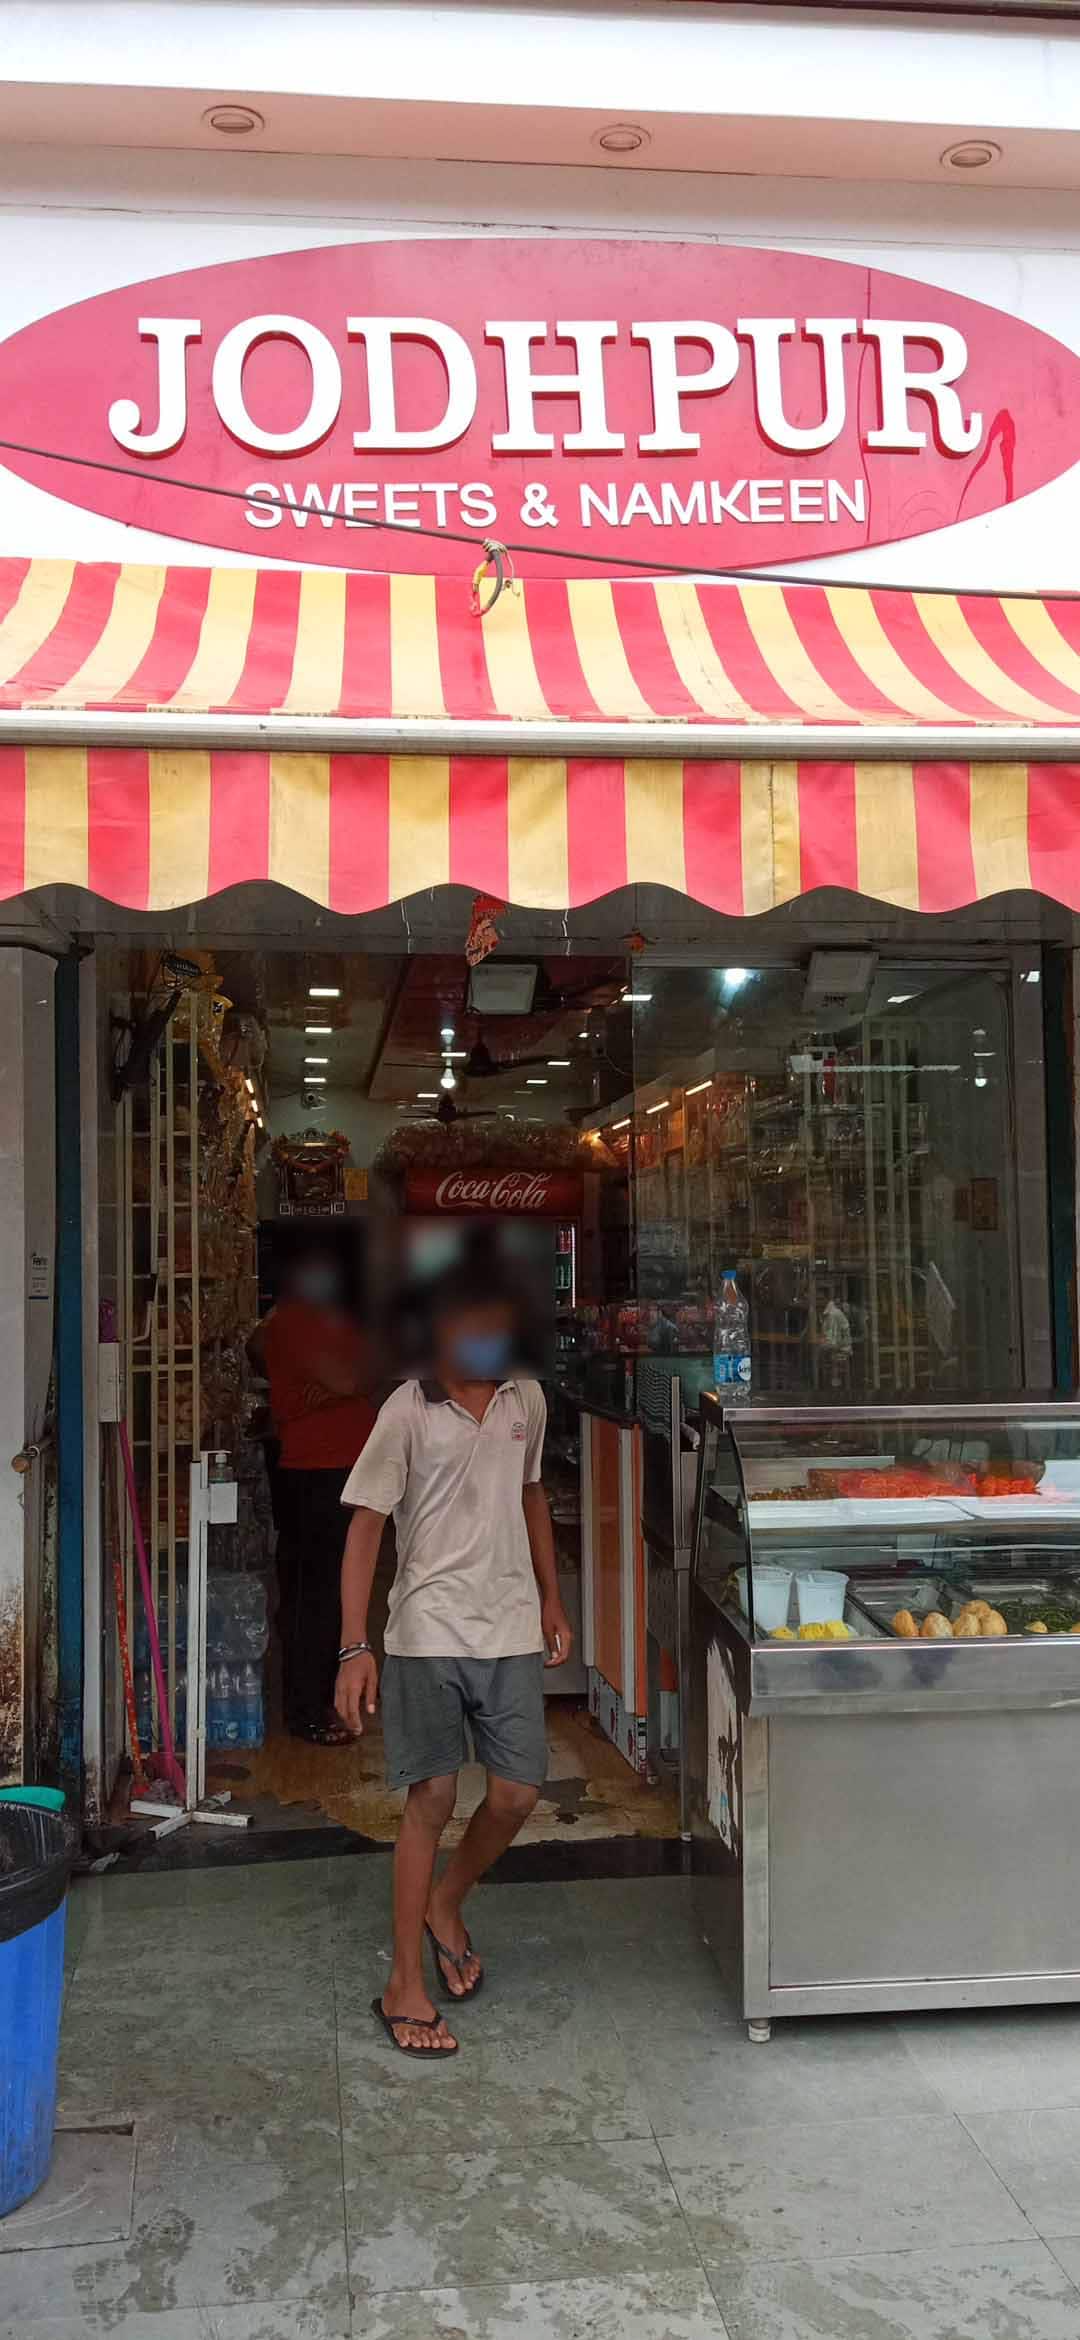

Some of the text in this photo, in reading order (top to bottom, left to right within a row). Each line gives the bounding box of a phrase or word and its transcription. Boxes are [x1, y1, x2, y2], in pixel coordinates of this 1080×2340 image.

[108, 315, 983, 458] JODHPUR
[244, 479, 866, 528] SWEETS & NAMKEEN
